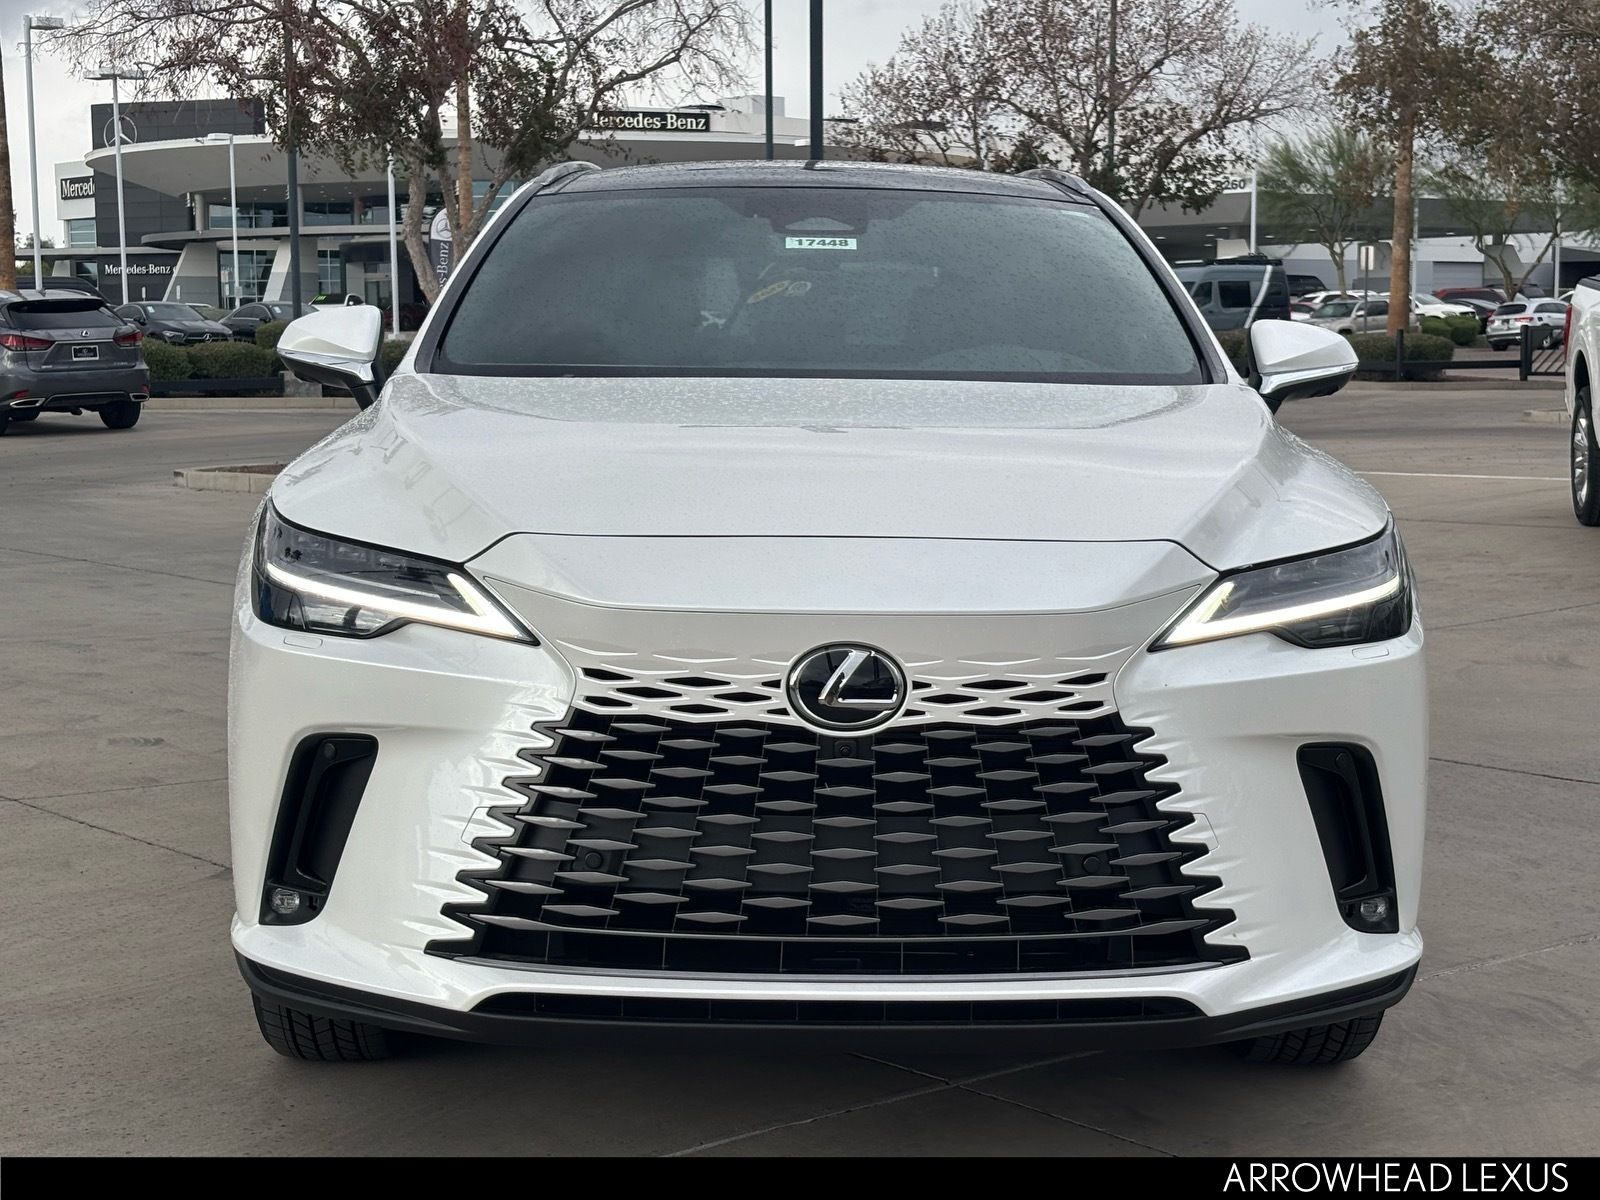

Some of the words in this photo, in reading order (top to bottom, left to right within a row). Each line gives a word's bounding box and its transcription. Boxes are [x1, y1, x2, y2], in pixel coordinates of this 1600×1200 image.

[1215, 179, 1246, 190] 260
[795, 238, 849, 247] 17448
[104, 263, 171, 275] Meredes-Benz
[436, 241, 449, 288] s-Benz
